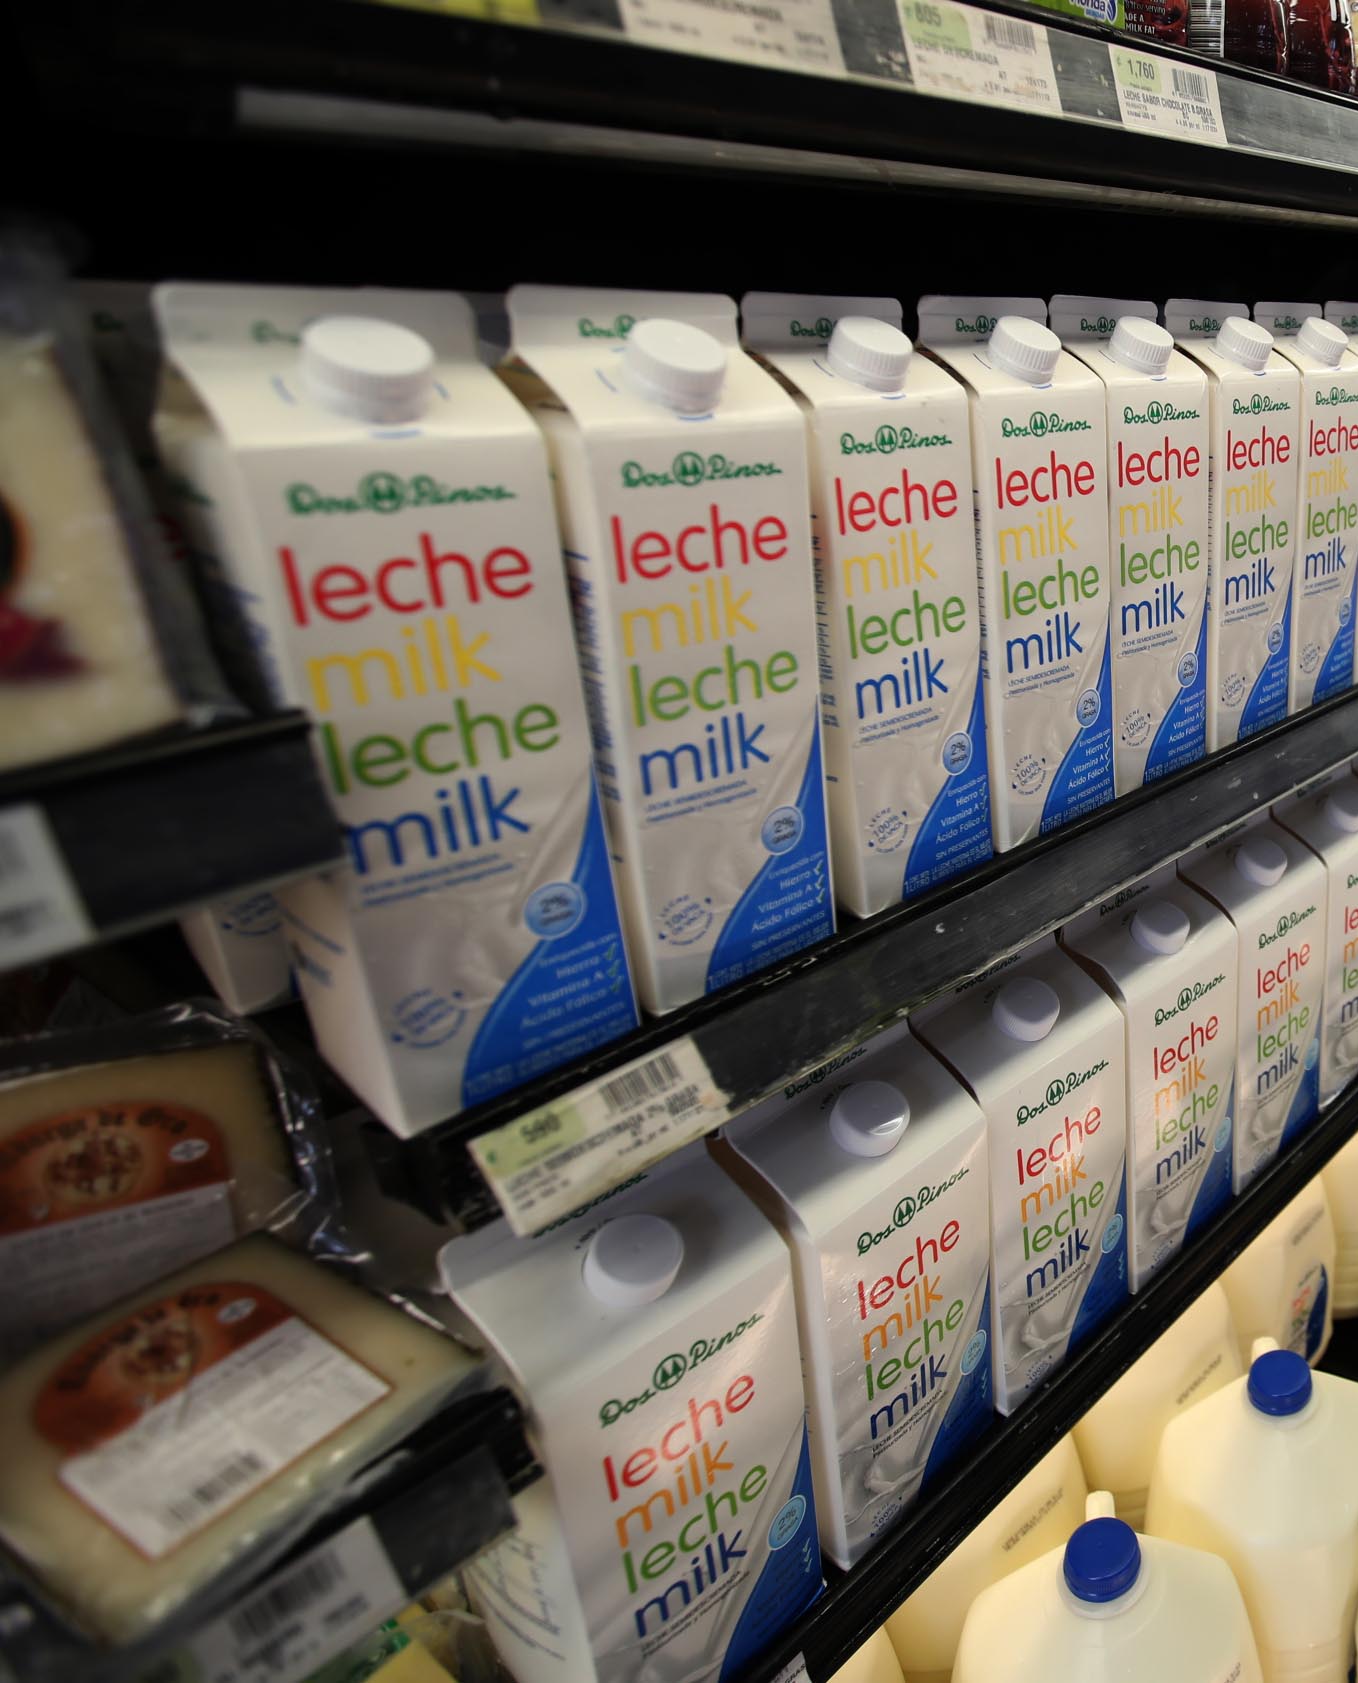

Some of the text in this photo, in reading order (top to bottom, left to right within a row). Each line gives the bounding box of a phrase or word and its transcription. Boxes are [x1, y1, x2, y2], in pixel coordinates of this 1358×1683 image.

[1126, 23, 1156, 35] MILK FAT
[1127, 59, 1156, 80] 1,760
[1001, 412, 1092, 438] Dos Pinos
[1123, 402, 1200, 424] Dos Pinos
[1232, 394, 1292, 416] Dos Pinos
[840, 426, 953, 455] Dos Pinos
[1116, 436, 1201, 489] leche
[1226, 425, 1291, 472] leche
[834, 467, 959, 537] leche
[995, 449, 1095, 510] leche
[1224, 467, 1278, 518] milk
[997, 502, 1079, 565] milk
[1118, 484, 1185, 538] milk
[1225, 514, 1290, 562] leche
[1306, 496, 1358, 540] leche
[610, 503, 789, 584] leche
[842, 527, 939, 599] milk
[1120, 533, 1201, 588] leche
[1304, 536, 1347, 581] milk
[278, 531, 534, 628] leche
[1001, 558, 1101, 620] leche
[1121, 580, 1186, 636] milk
[1224, 556, 1276, 606] milk
[621, 575, 759, 656] milk
[846, 589, 967, 660] leche
[1006, 611, 1084, 674] milk
[306, 613, 502, 713] milk
[629, 643, 799, 729] leche
[856, 647, 949, 720] milk
[1183, 659, 1195, 672] 2%
[1083, 697, 1096, 711] 2%
[1126, 715, 1145, 734] 100%
[1173, 715, 1196, 730] Vitamina
[1184, 702, 1200, 714] Hierro
[317, 696, 561, 797] leche
[639, 711, 771, 797] milk
[950, 740, 967, 756] 2%
[1015, 760, 1040, 781] 100%
[1072, 754, 1105, 776] Vitamina A
[1085, 741, 1104, 757] Hierro
[955, 790, 979, 807] Hierro
[1067, 774, 1087, 790] Ácido
[343, 775, 531, 876] milk
[940, 802, 980, 827] Vitamina A
[1258, 904, 1317, 951] Dos Pinos
[1154, 972, 1227, 1028] Dos Pinos
[1256, 943, 1311, 999] leche
[1257, 979, 1301, 1032] milk
[1257, 1005, 1310, 1064] leche
[1153, 1015, 1219, 1081] leche
[1257, 1041, 1300, 1096] milk
[1016, 1058, 1110, 1128] Dos Pinos
[1155, 1054, 1207, 1116] milk
[1016, 1105, 1102, 1186] leche
[1155, 1084, 1220, 1151] leche
[1156, 1124, 1207, 1185] milk
[857, 1166, 970, 1257] Dos Pinos
[1020, 1153, 1089, 1225] milk
[1023, 1180, 1105, 1262] leche
[857, 1218, 961, 1322] leche
[1026, 1227, 1091, 1298] milk
[862, 1274, 944, 1362] milk
[599, 1310, 766, 1429] Dos Pinos
[865, 1298, 965, 1402] leche
[869, 1353, 948, 1441] milk
[602, 1374, 756, 1503] leche
[614, 1440, 735, 1550] milk
[776, 1505, 798, 1531] 2%
[620, 1463, 769, 1596] leche
[634, 1529, 748, 1639] milk
